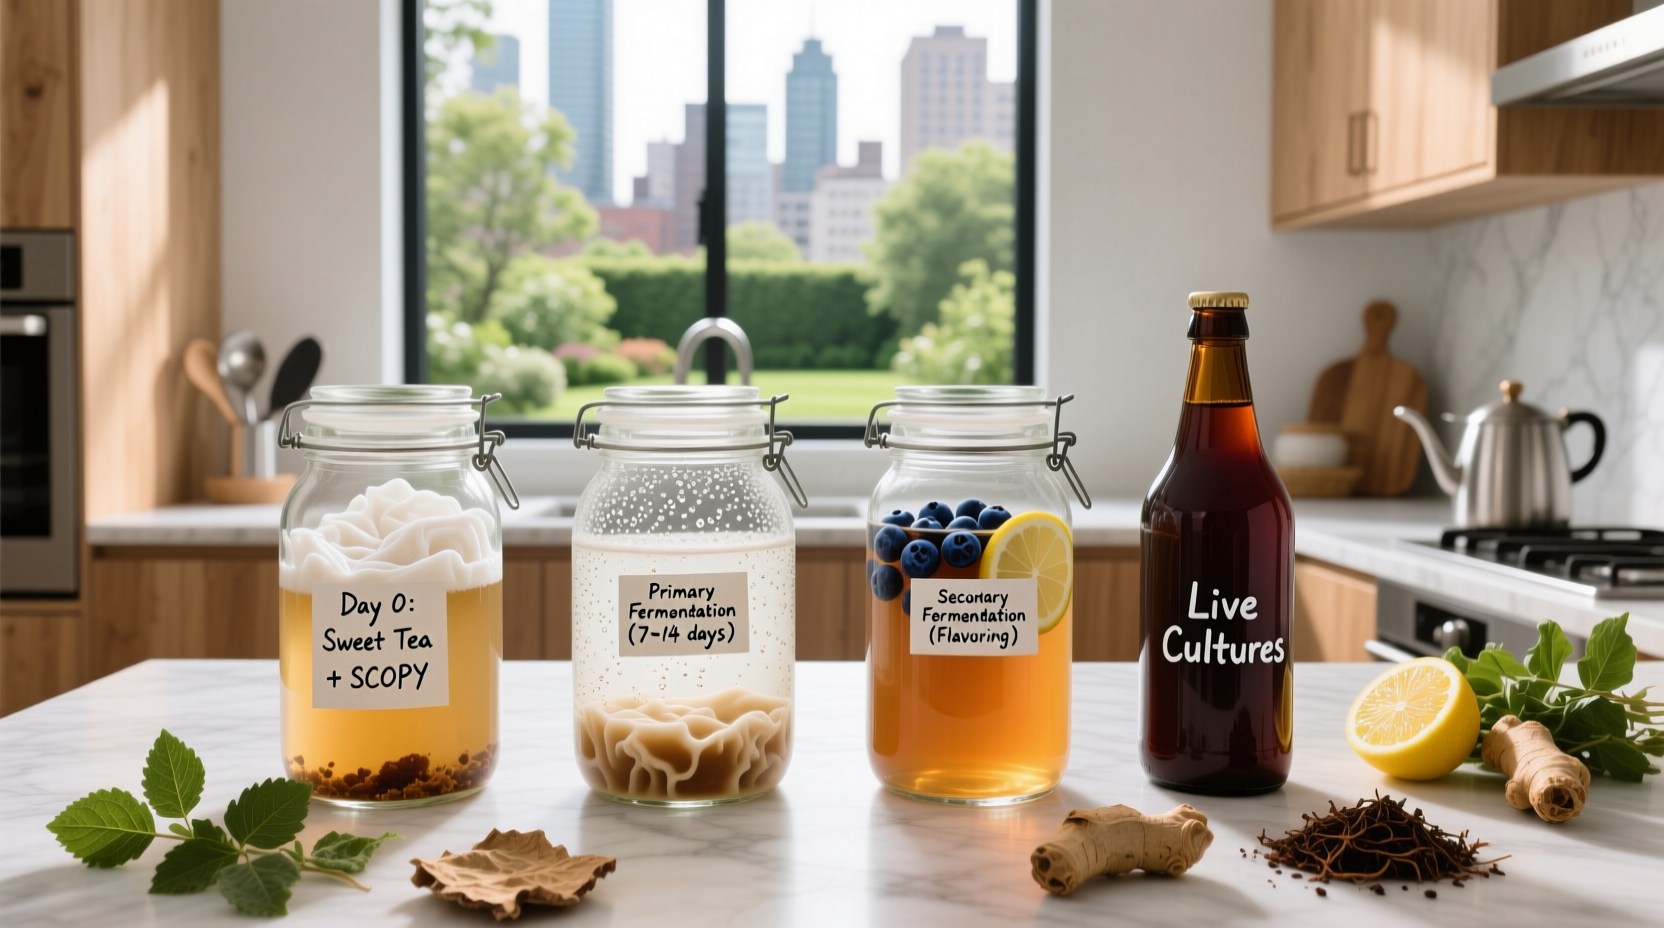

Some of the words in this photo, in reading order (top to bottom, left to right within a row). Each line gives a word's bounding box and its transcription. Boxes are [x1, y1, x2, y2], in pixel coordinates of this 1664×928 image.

[648, 582, 715, 602] Primary
[1188, 580, 1259, 620] Live
[340, 591, 382, 627] Day
[322, 627, 386, 652] Sweet
[393, 626, 434, 650] Tea
[628, 622, 680, 647] (7-14
[687, 621, 735, 650] days)
[929, 624, 1018, 650] (Flavoring)
[1162, 624, 1286, 666] Cultures
[326, 669, 342, 689] +
[350, 661, 429, 691] SCOPY
